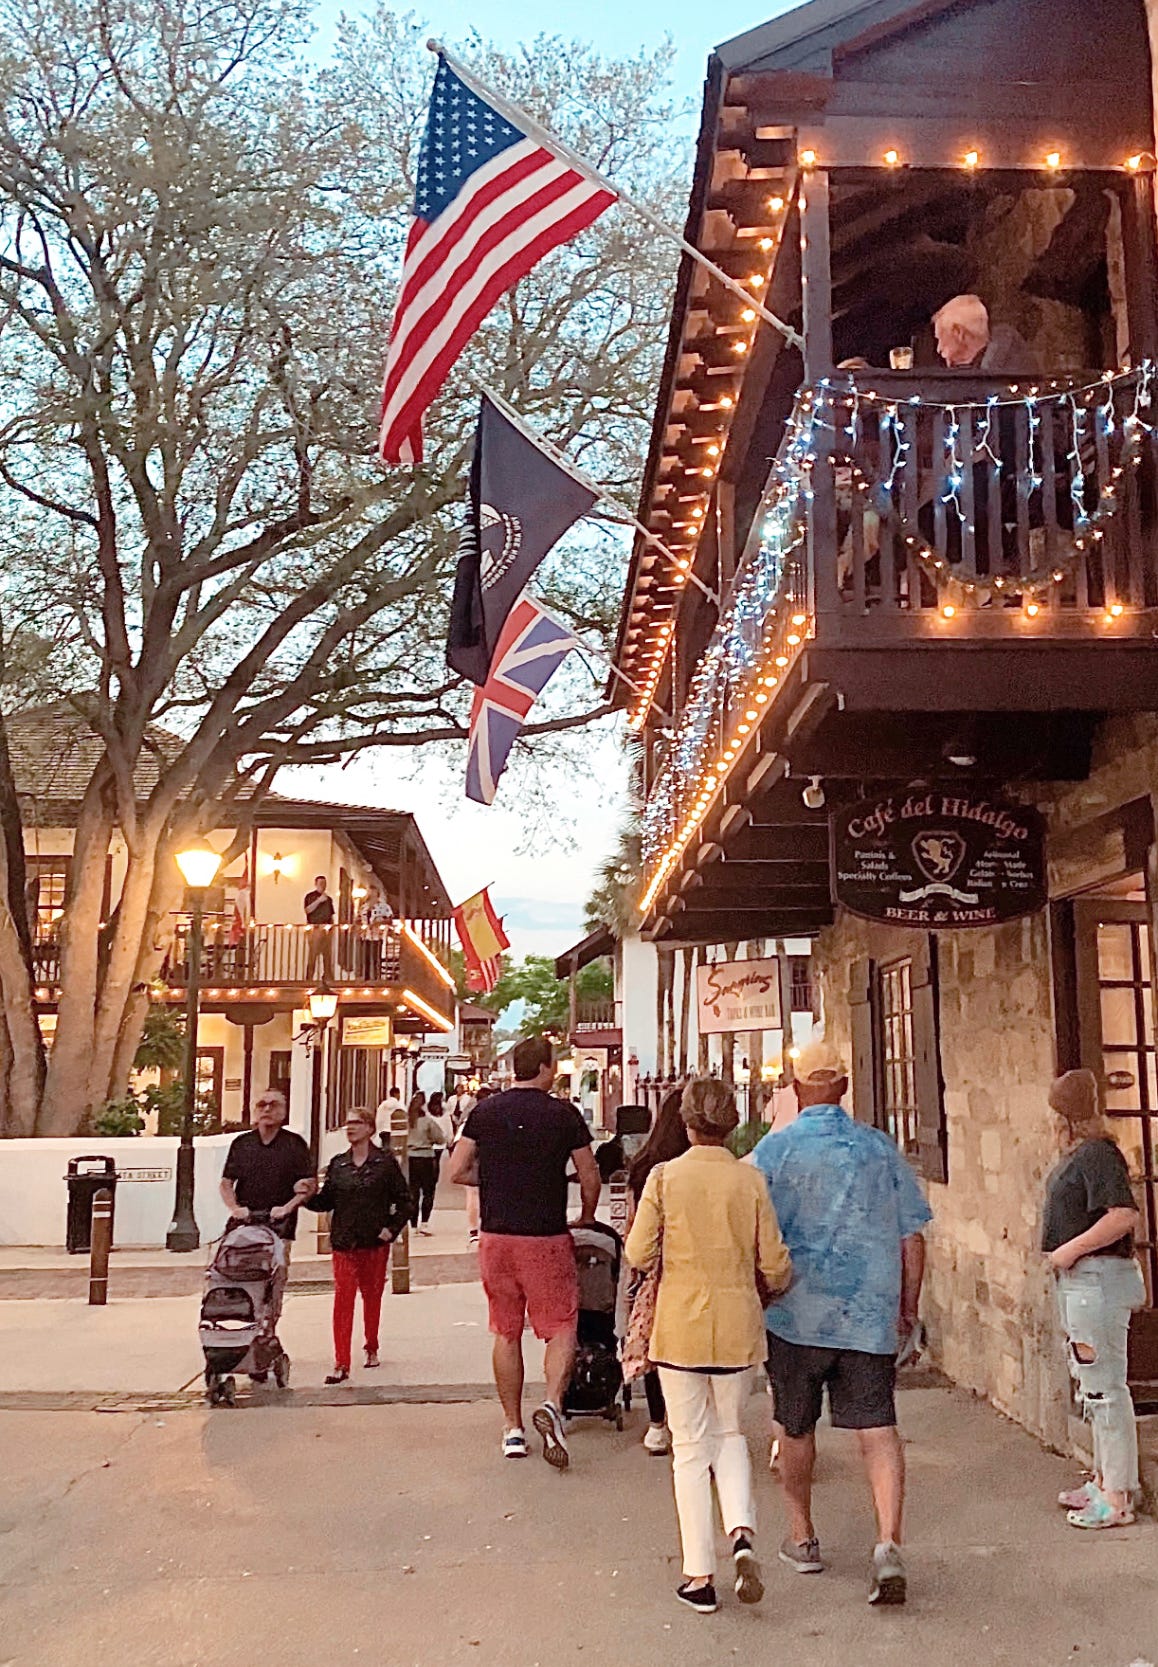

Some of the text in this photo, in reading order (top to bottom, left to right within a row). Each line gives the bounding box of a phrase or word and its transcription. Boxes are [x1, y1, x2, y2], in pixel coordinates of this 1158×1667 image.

[848, 794, 1028, 840] Café del Hidalgo
[886, 906, 996, 922] BEER & WINE
